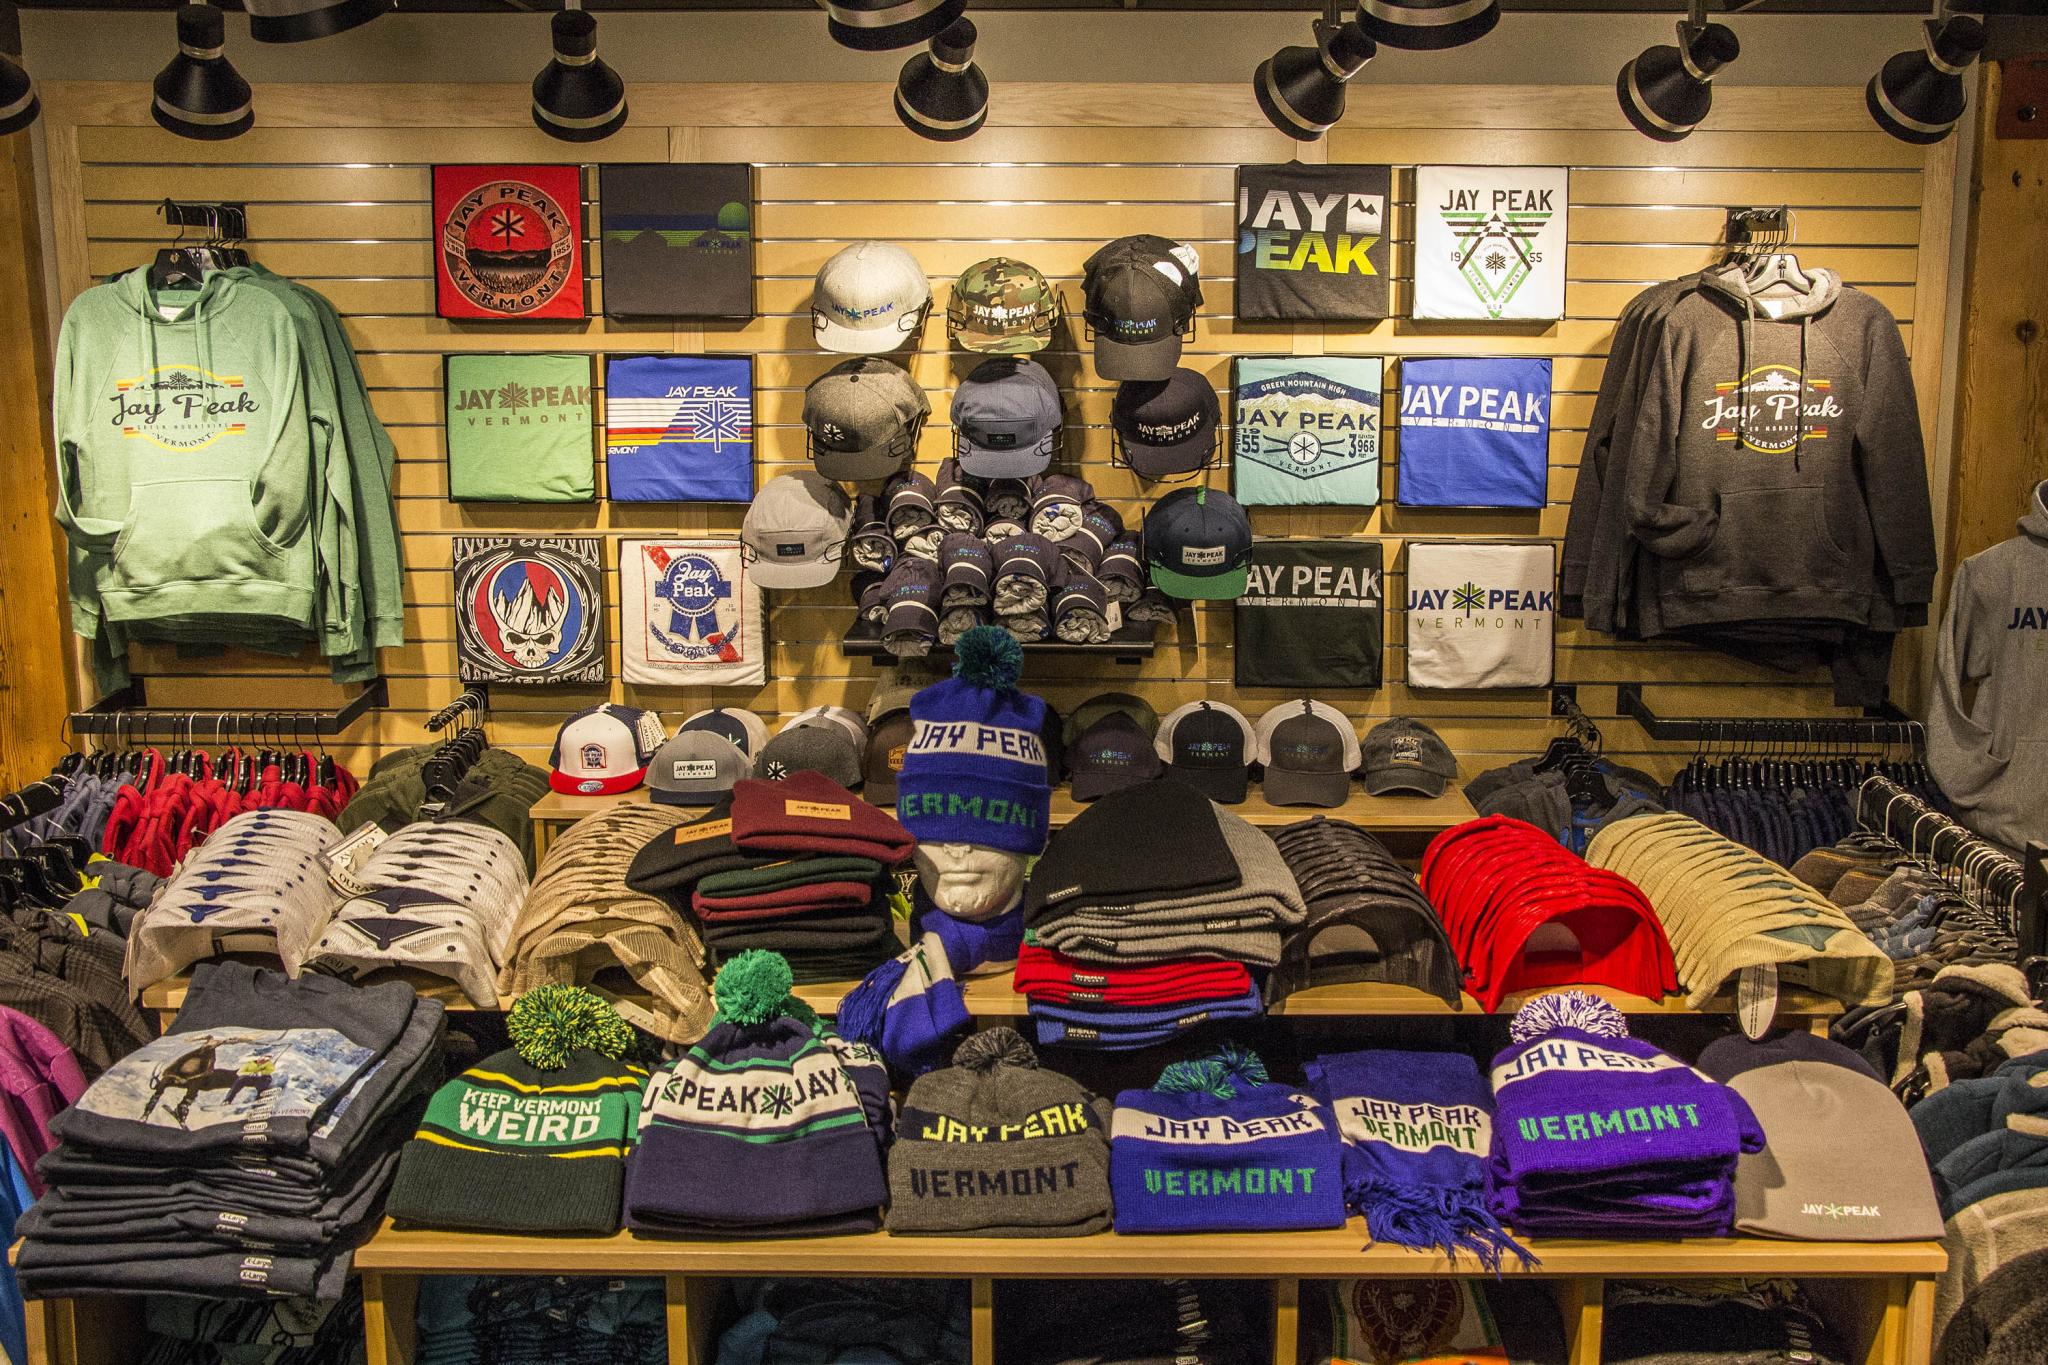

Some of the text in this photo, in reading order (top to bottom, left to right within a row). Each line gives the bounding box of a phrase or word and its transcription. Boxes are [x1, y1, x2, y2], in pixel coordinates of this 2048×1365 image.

[453, 187, 562, 233] JAY PEAK
[1440, 189, 1553, 211] JAY PEAK
[1450, 251, 1461, 262] 19
[1529, 252, 1543, 263] 55
[457, 270, 561, 310] VERMONT
[863, 301, 894, 319] PEAK
[973, 302, 1036, 319] JAY PEAK
[454, 385, 591, 411] JAY PEAK
[665, 386, 737, 399] JAY PEAK
[1260, 379, 1347, 395] GREEN MOUNTAIN HIGH
[109, 391, 260, 426] Jay Peak
[1400, 384, 1545, 423] JAY PEAK
[1701, 396, 1761, 430] Jay
[467, 412, 584, 427] VERMONT
[1137, 411, 1200, 435] JAY PEAK
[1236, 408, 1377, 431] JAY PEAK
[156, 432, 212, 447] VERMONT
[1241, 434, 1260, 454] 55
[1357, 440, 1375, 453] 968
[1749, 434, 1798, 449] VERMONT
[1279, 461, 1332, 474] VERMONT
[1206, 550, 1224, 558] PEAK
[673, 561, 713, 583] Jay
[1245, 565, 1382, 598] AY PEAK
[672, 582, 716, 598] Peak
[1407, 589, 1553, 612] JAY PEAK
[1417, 617, 1541, 630] VERMONT
[912, 723, 1044, 761] JAY PEAK
[1504, 1043, 1568, 1082] JAY
[463, 1087, 602, 1117] KEEP VERMONT
[679, 1078, 762, 1115] PEAK
[793, 1067, 838, 1107] JAY
[458, 1102, 602, 1142] WEIRD
[1351, 1099, 1482, 1128] JAY PEAK
[1517, 1103, 1700, 1142] VERMONT
[244, 1122, 267, 1130] Small
[922, 1115, 988, 1143] JAY
[1145, 1112, 1313, 1141] JAY PEAK
[1362, 1116, 1477, 1150] VERMONT
[910, 1161, 1079, 1200] VERMONT
[1144, 1166, 1317, 1197] VERMONT
[1801, 1203, 1881, 1217] JAY PEAK
[242, 1270, 268, 1280] X-Large
